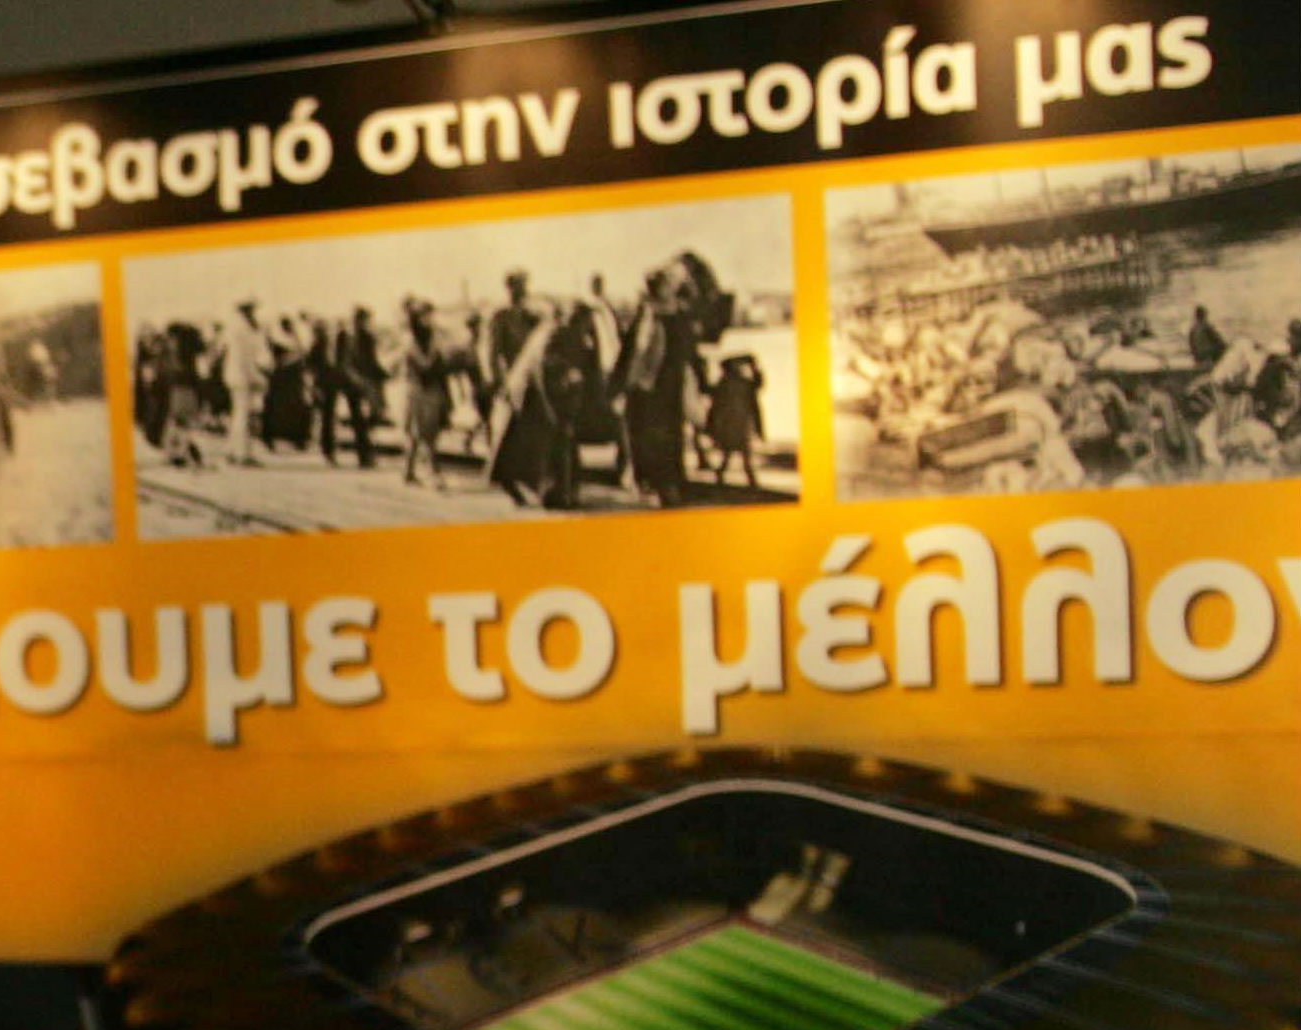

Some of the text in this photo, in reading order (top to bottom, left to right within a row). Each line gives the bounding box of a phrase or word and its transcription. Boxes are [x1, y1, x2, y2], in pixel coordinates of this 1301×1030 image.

[356, 88, 580, 175] στην
[608, 25, 978, 151] ιστορία
[1015, 15, 1214, 129] μας
[428, 585, 616, 702] το
[678, 517, 1301, 735] μέλλο
